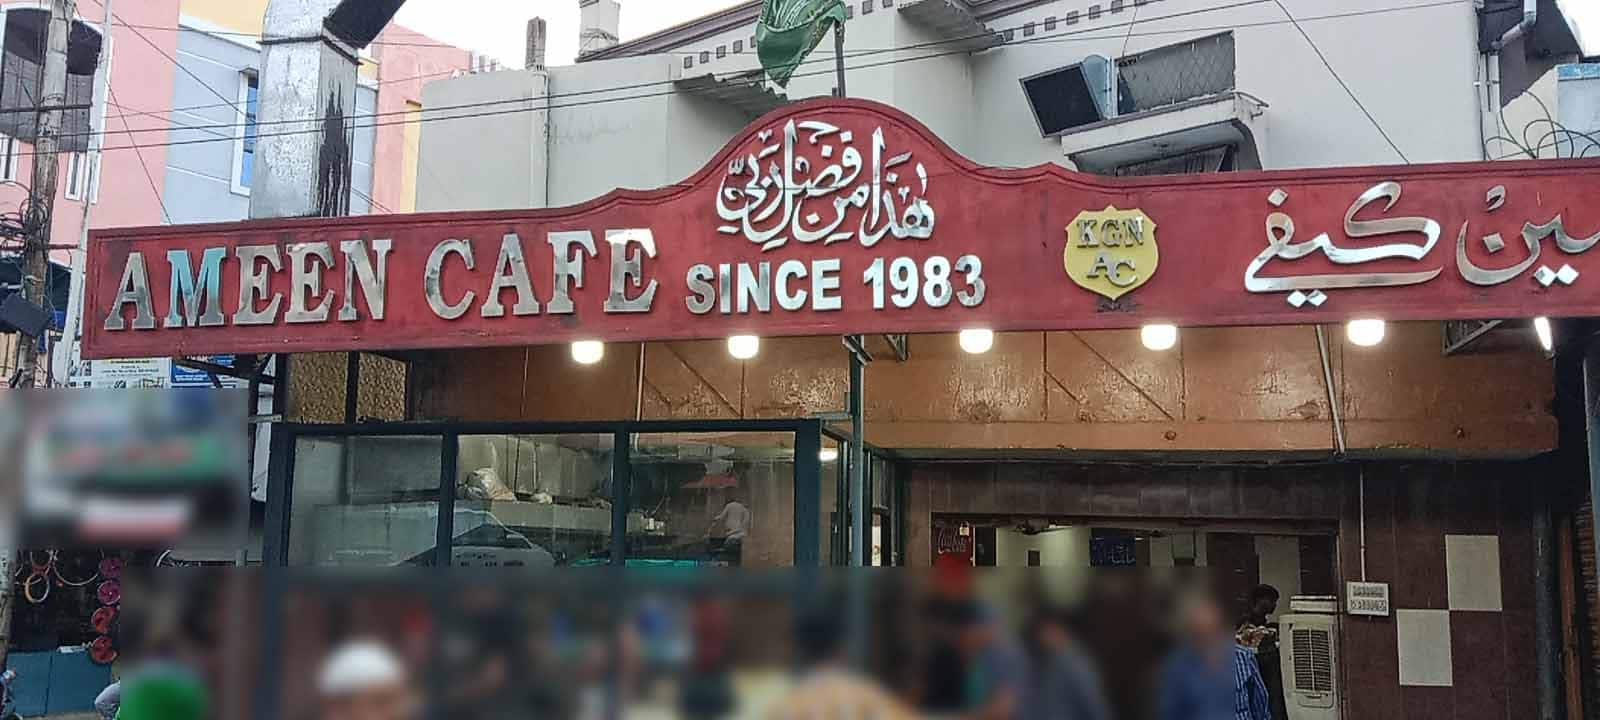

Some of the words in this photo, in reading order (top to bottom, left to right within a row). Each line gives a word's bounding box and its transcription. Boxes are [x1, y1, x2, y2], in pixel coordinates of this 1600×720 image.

[1077, 216, 1144, 248] KGN
[104, 239, 392, 330] AMEEN
[424, 228, 658, 320] CAFE
[685, 258, 842, 314] SINCE
[863, 255, 986, 309] 1983
[1086, 250, 1137, 287] AC
